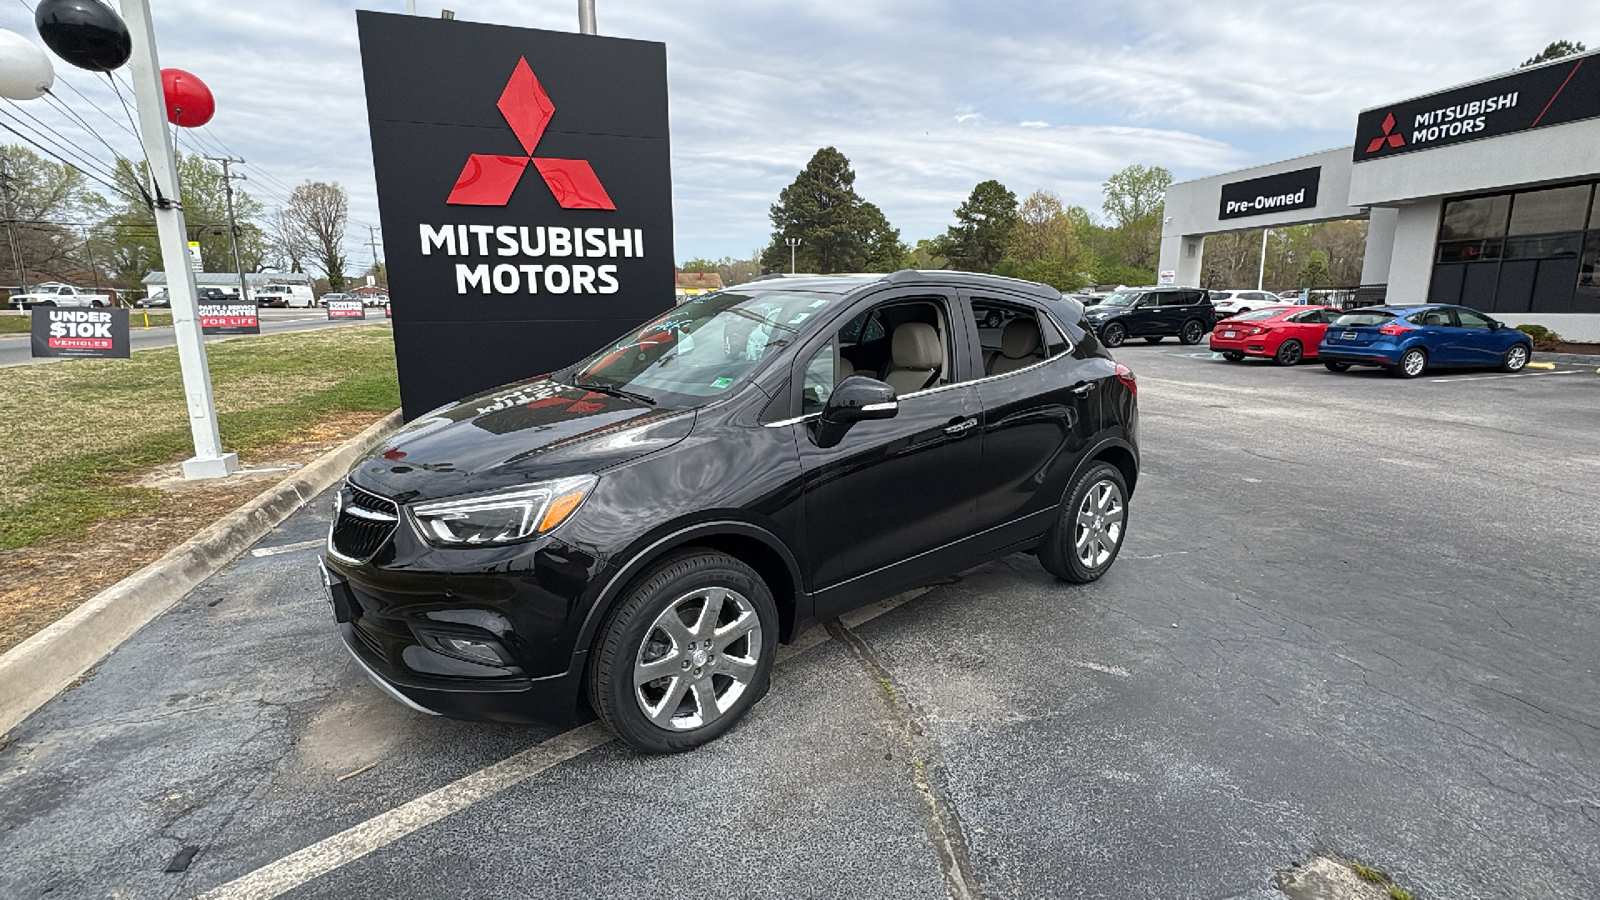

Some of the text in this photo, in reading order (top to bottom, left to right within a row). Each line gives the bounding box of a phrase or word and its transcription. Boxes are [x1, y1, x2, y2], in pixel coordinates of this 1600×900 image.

[1414, 91, 1519, 128] MITSUBISHI
[1411, 116, 1486, 144] MOTORS
[1226, 187, 1305, 214] Pre-Owned
[419, 223, 644, 257] MITSUBISHI
[454, 264, 620, 295] MOTORS
[49, 310, 112, 323] UNDER
[49, 321, 113, 338] $10K
[53, 339, 108, 347] VEHICLES
